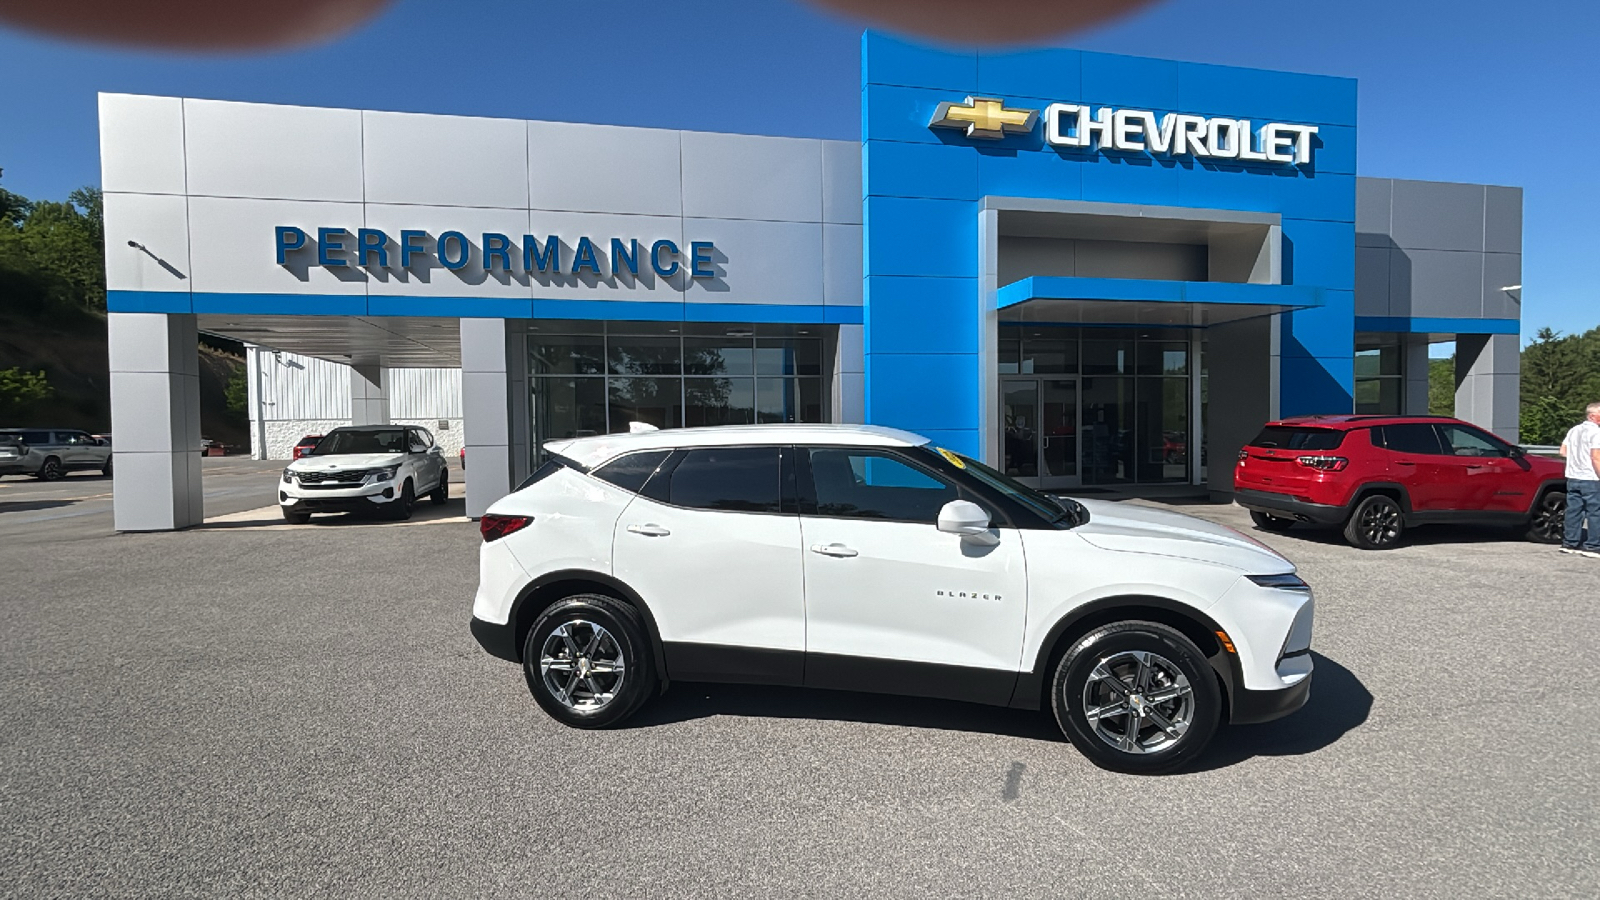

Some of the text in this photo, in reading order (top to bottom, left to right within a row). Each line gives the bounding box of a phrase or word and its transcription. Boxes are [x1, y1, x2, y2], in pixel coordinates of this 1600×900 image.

[1044, 102, 1319, 164] CHEVROLET
[275, 226, 715, 278] PERFORMANCE
[936, 590, 1003, 601] BLAZER
